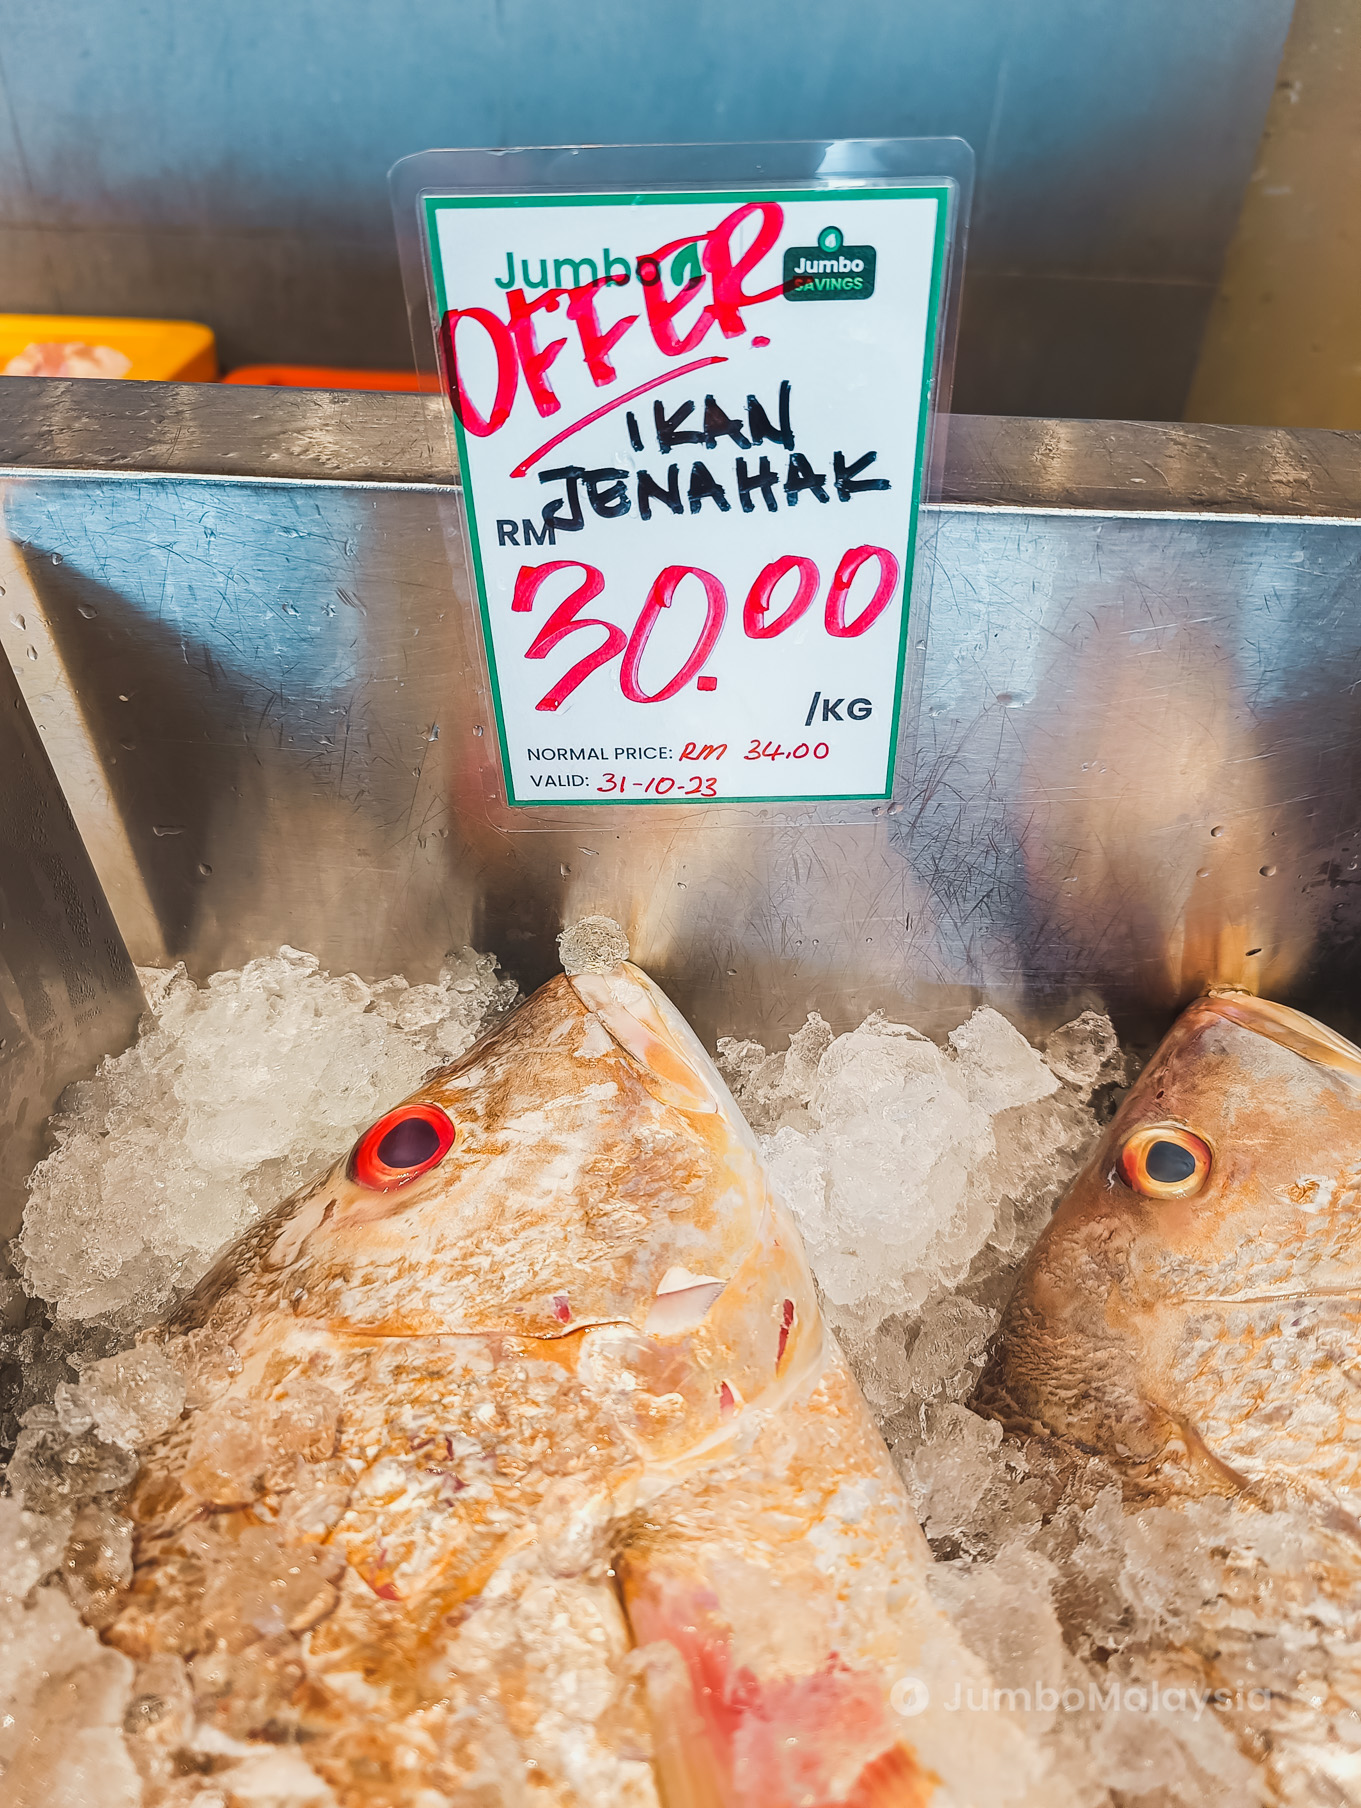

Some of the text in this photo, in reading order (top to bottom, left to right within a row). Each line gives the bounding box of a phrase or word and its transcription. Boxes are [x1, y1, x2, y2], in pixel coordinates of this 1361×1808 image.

[494, 248, 661, 290] Jumbo
[793, 255, 865, 274] Jumbo
[793, 277, 864, 292] SAVINGS
[626, 380, 794, 453] IKAN
[538, 450, 892, 531] JENAHAK
[496, 519, 556, 547] RM
[805, 691, 873, 727] /KG
[527, 746, 609, 762] NORMAL
[614, 746, 673, 761] PRICE:
[678, 741, 728, 762] RM
[530, 773, 718, 797] VALID: 31-10-23
